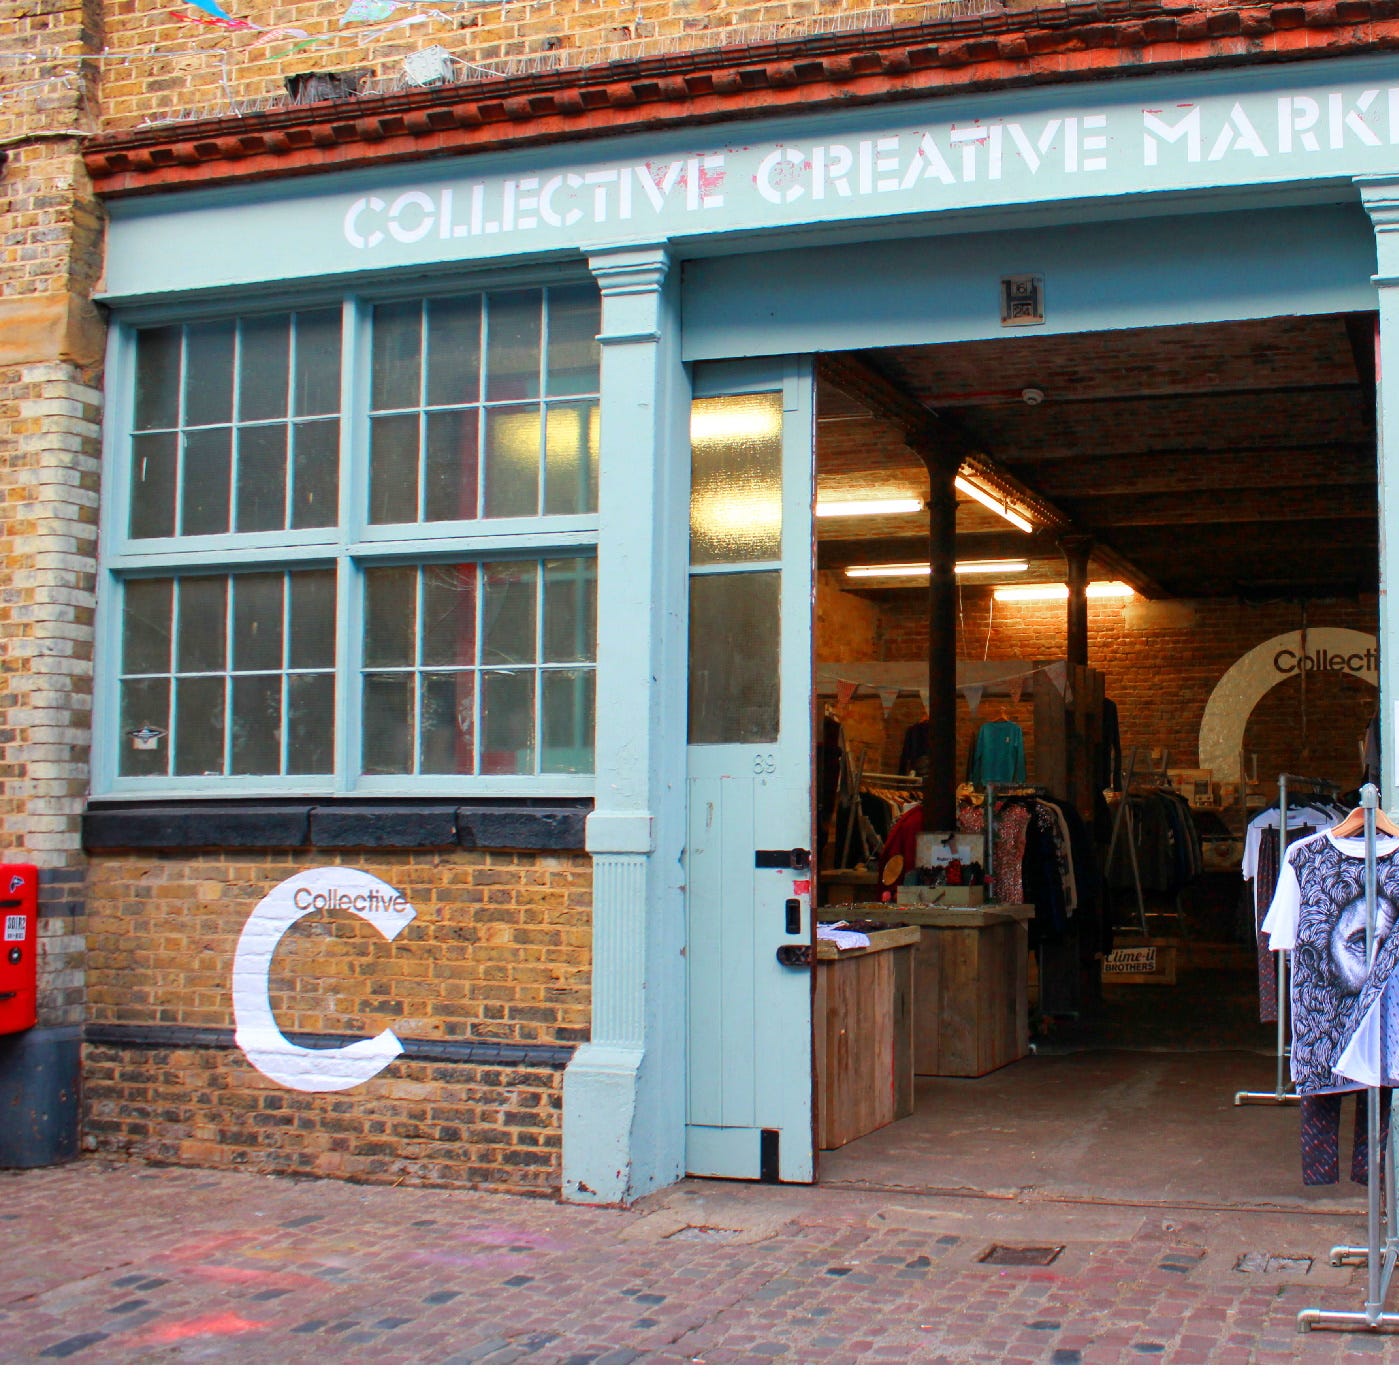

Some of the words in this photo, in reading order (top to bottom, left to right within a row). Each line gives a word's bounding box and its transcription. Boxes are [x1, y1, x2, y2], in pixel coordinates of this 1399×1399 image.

[344, 154, 725, 250] COLLECTIVE
[755, 114, 1107, 205] CREATIVE
[1274, 648, 1378, 674] Collecti
[293, 887, 410, 913] Collective
